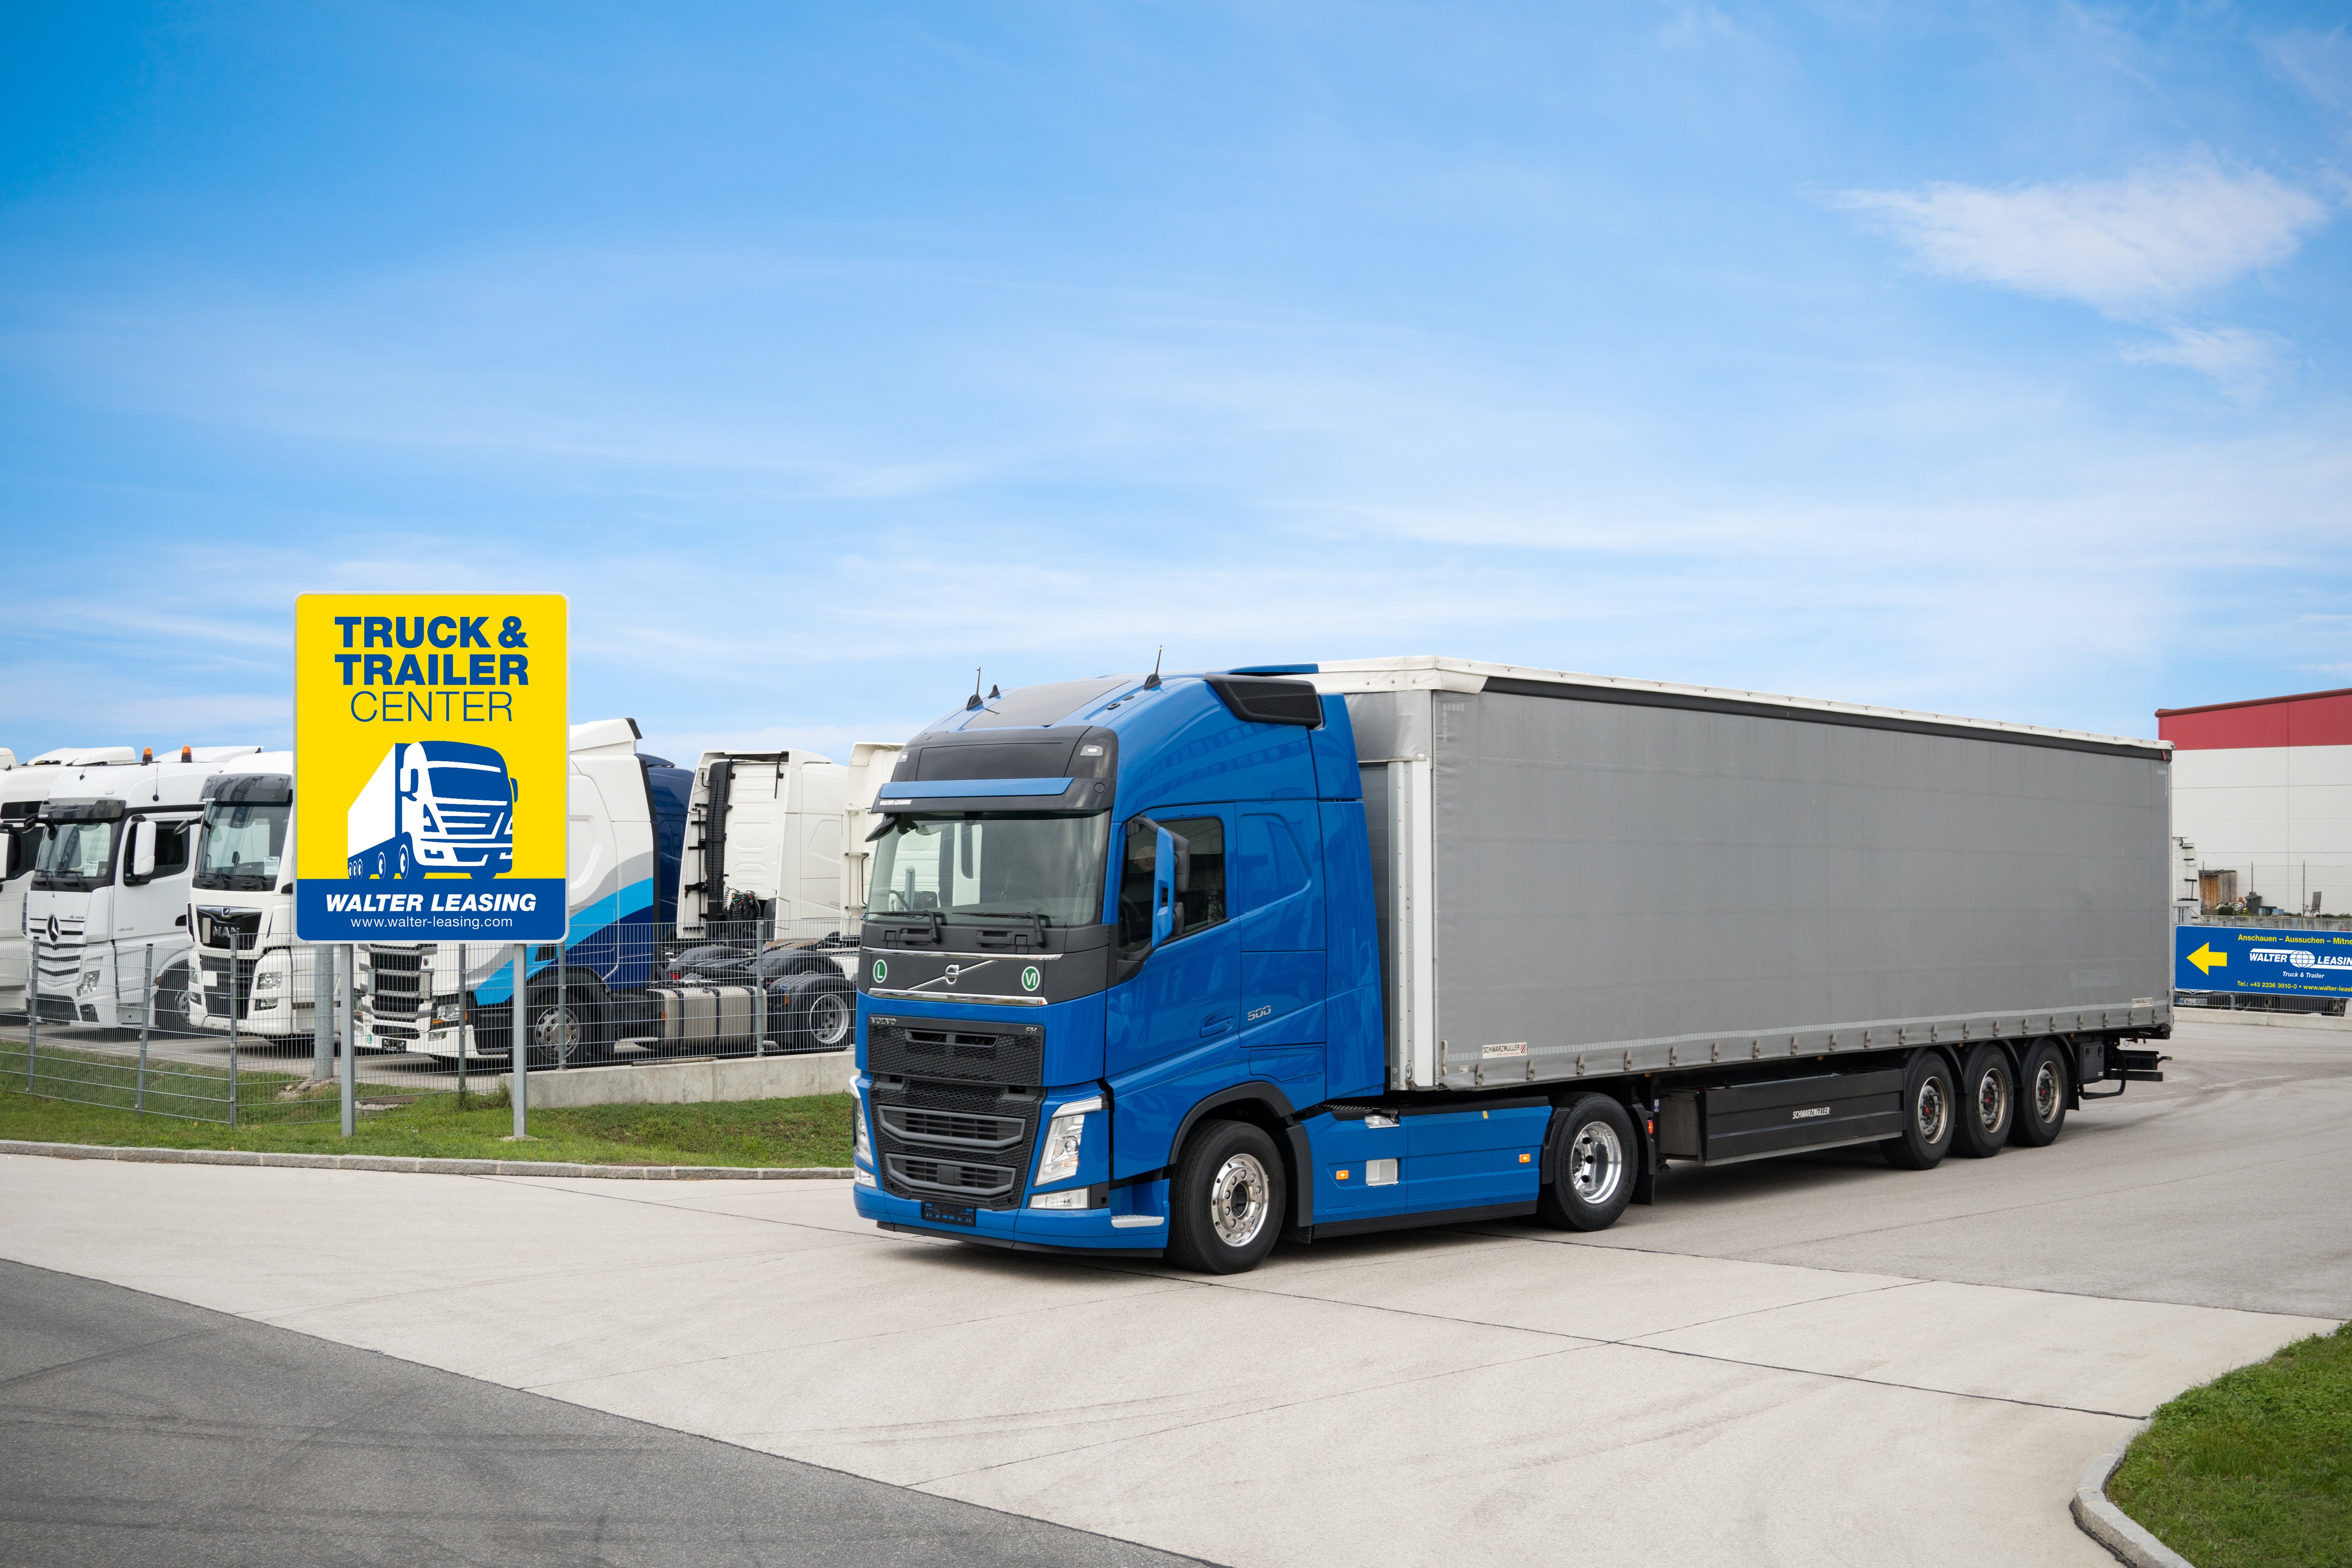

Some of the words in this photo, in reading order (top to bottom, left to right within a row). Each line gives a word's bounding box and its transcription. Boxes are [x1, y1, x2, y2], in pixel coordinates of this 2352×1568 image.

[334, 616, 492, 649] TRUCK
[498, 616, 529, 649] &
[334, 654, 529, 685] TRAILER
[351, 691, 513, 722] CENTER
[326, 894, 424, 912] WALTER
[430, 893, 537, 912] LEASING
[351, 916, 512, 929] www.walter-leasing.com
[2285, 935, 2324, 944] Aussuchen
[2250, 953, 2288, 962] WALTER
[877, 964, 883, 979] L
[1025, 972, 1036, 986] VI
[1247, 1005, 1271, 1021] 500
[870, 1017, 897, 1025] VOLVO
[1483, 1044, 1520, 1053] SCHWARZMÜLLER
